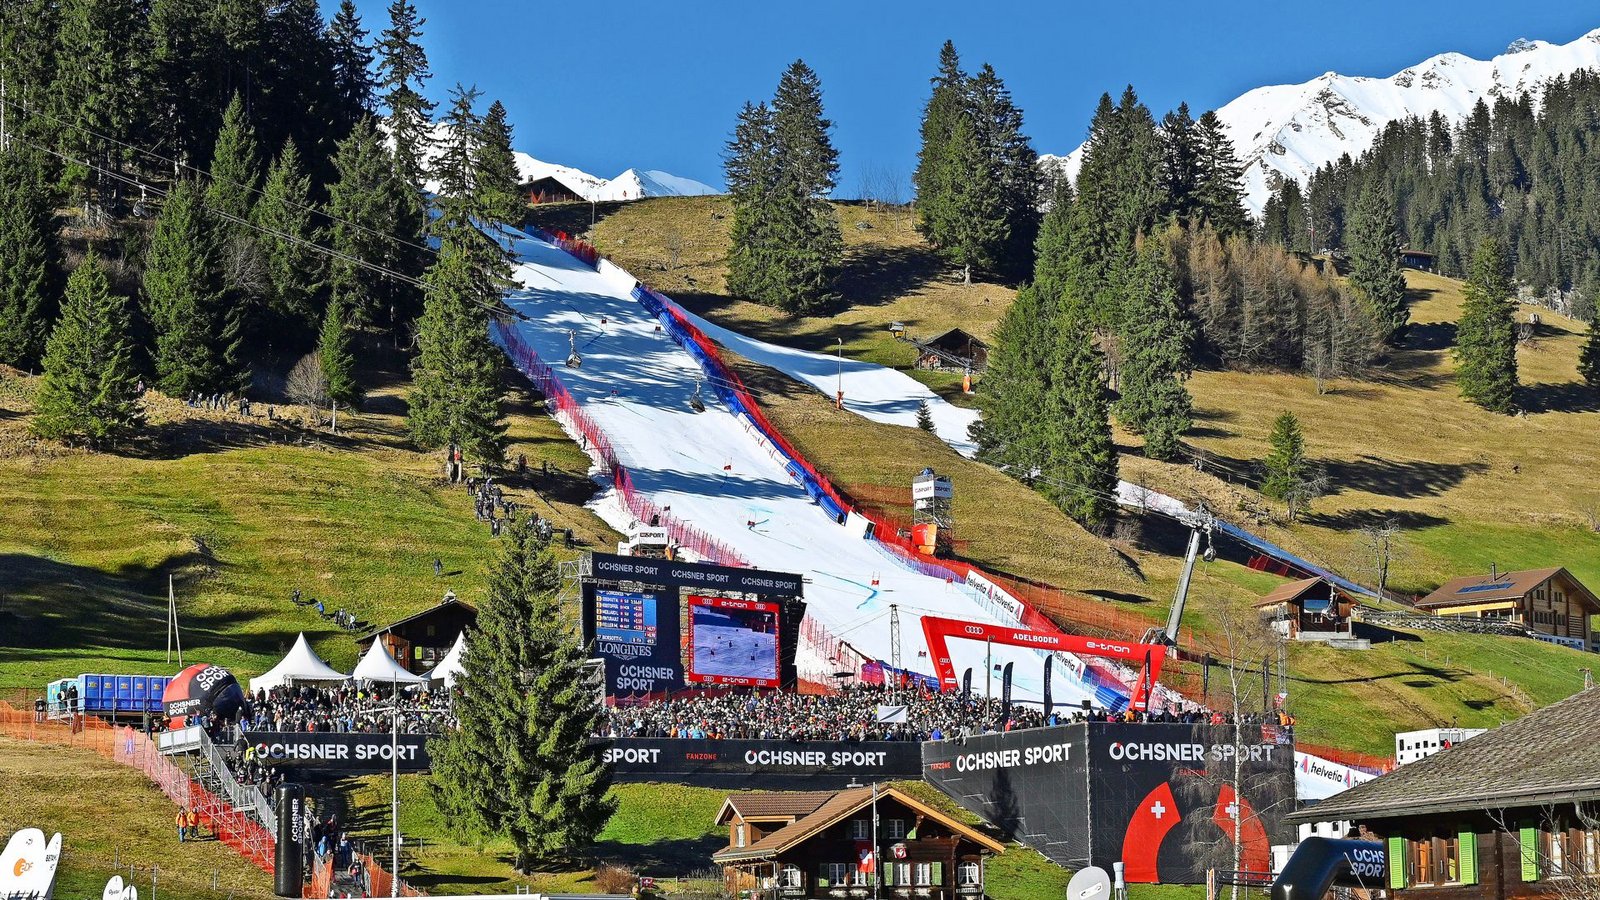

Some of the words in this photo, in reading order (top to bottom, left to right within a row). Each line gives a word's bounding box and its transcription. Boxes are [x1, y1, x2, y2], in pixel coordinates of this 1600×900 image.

[598, 562, 633, 572] OCHSNER
[634, 565, 658, 575] SPORT
[672, 570, 704, 580] OCHSNER
[706, 573, 729, 582] SPORT
[742, 577, 774, 588] OCHSNER
[775, 580, 796, 590] SPORT
[967, 575, 986, 594] helvetia
[994, 590, 1014, 613] helvetia
[1013, 633, 1058, 644] ADELBODEN
[599, 642, 652, 656] LONGINES
[1086, 641, 1130, 653] e-tron
[620, 664, 674, 680] OCHSNER
[617, 677, 654, 690] SPORT
[170, 699, 200, 708] OCHSNER
[169, 707, 188, 715] SPORT
[255, 743, 349, 760] OCHSNER
[355, 745, 418, 760] SPORT
[602, 748, 660, 763] SPORT
[744, 750, 826, 766] OCHSNER
[832, 752, 886, 766] SPORT
[956, 749, 1020, 772] OCHSNER
[1025, 742, 1072, 765] SPORT
[1109, 742, 1204, 761] OCHSNER
[1211, 744, 1274, 762] SPORT
[1310, 762, 1342, 782] helvetia
